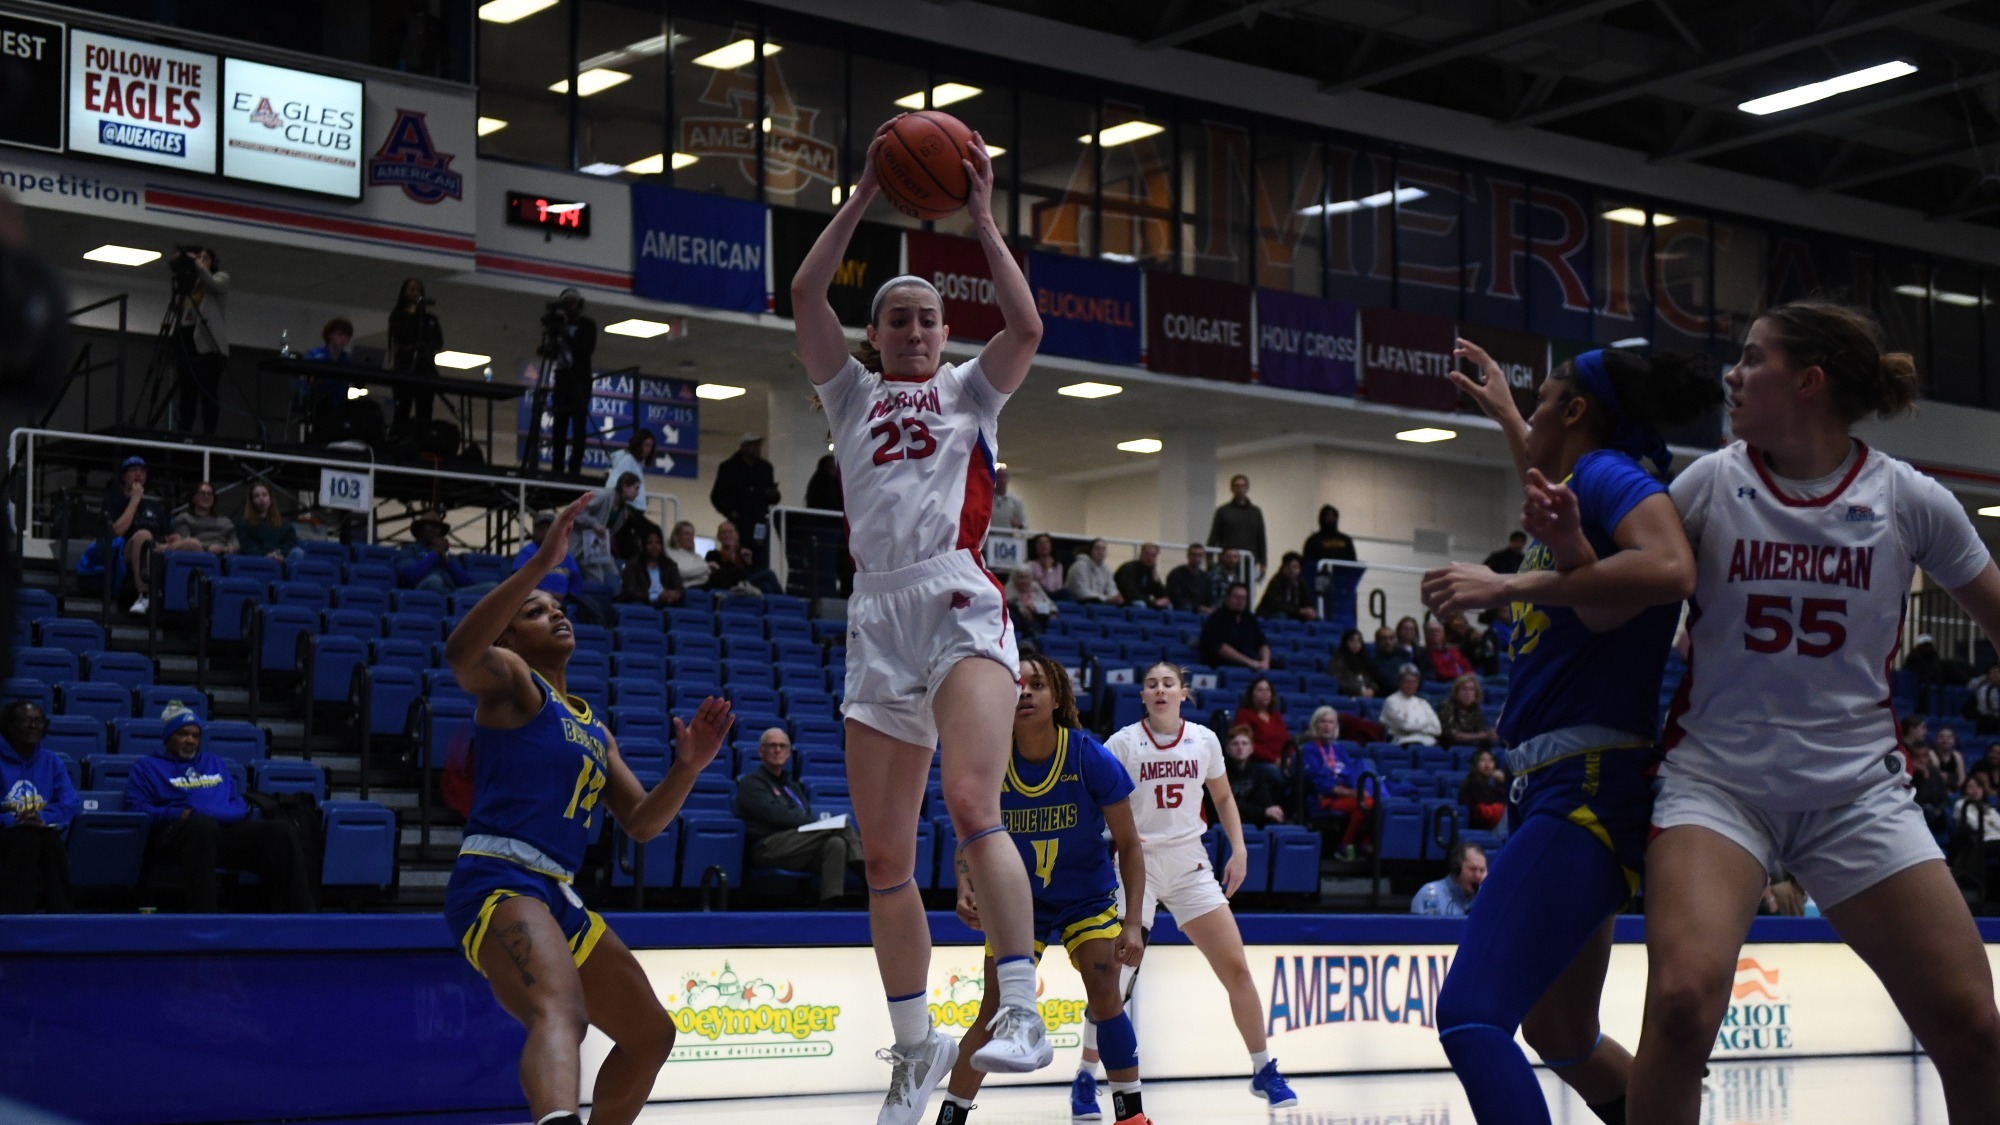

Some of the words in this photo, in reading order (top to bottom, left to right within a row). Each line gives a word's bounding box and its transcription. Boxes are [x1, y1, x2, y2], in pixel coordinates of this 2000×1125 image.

[0, 29, 47, 62] EST
[85, 44, 162, 80] FOLLOW
[167, 58, 201, 87] THE
[85, 72, 201, 129] EAGLES
[102, 122, 183, 154] @AUEAGLES
[285, 124, 352, 151] CLUB
[688, 125, 833, 171] AMERICAN
[376, 165, 458, 191] AMERICAN
[641, 229, 762, 272] AMERICAN
[831, 259, 868, 288] MY
[1036, 287, 1135, 328] BUCKNELL
[1163, 312, 1243, 348] COLGATE
[1260, 324, 1301, 352] HOLY
[1304, 331, 1356, 363] CROSS
[1366, 342, 1450, 376] LAFAYETTE
[590, 396, 628, 415] EXIT
[871, 416, 936, 467] 23
[330, 476, 360, 499] 103
[1728, 539, 1874, 591] AMERICAN
[1744, 593, 1848, 658] 55
[1140, 760, 1198, 782] AMERICAN
[1154, 783, 1185, 809] 15
[1002, 809, 1038, 833] BLUE
[1039, 803, 1078, 831] HENS
[1030, 838, 1060, 889] 4
[1265, 954, 1450, 1038] AMERICAN
[671, 1050, 719, 1060] unique
[728, 1045, 821, 1056] delicatessen
